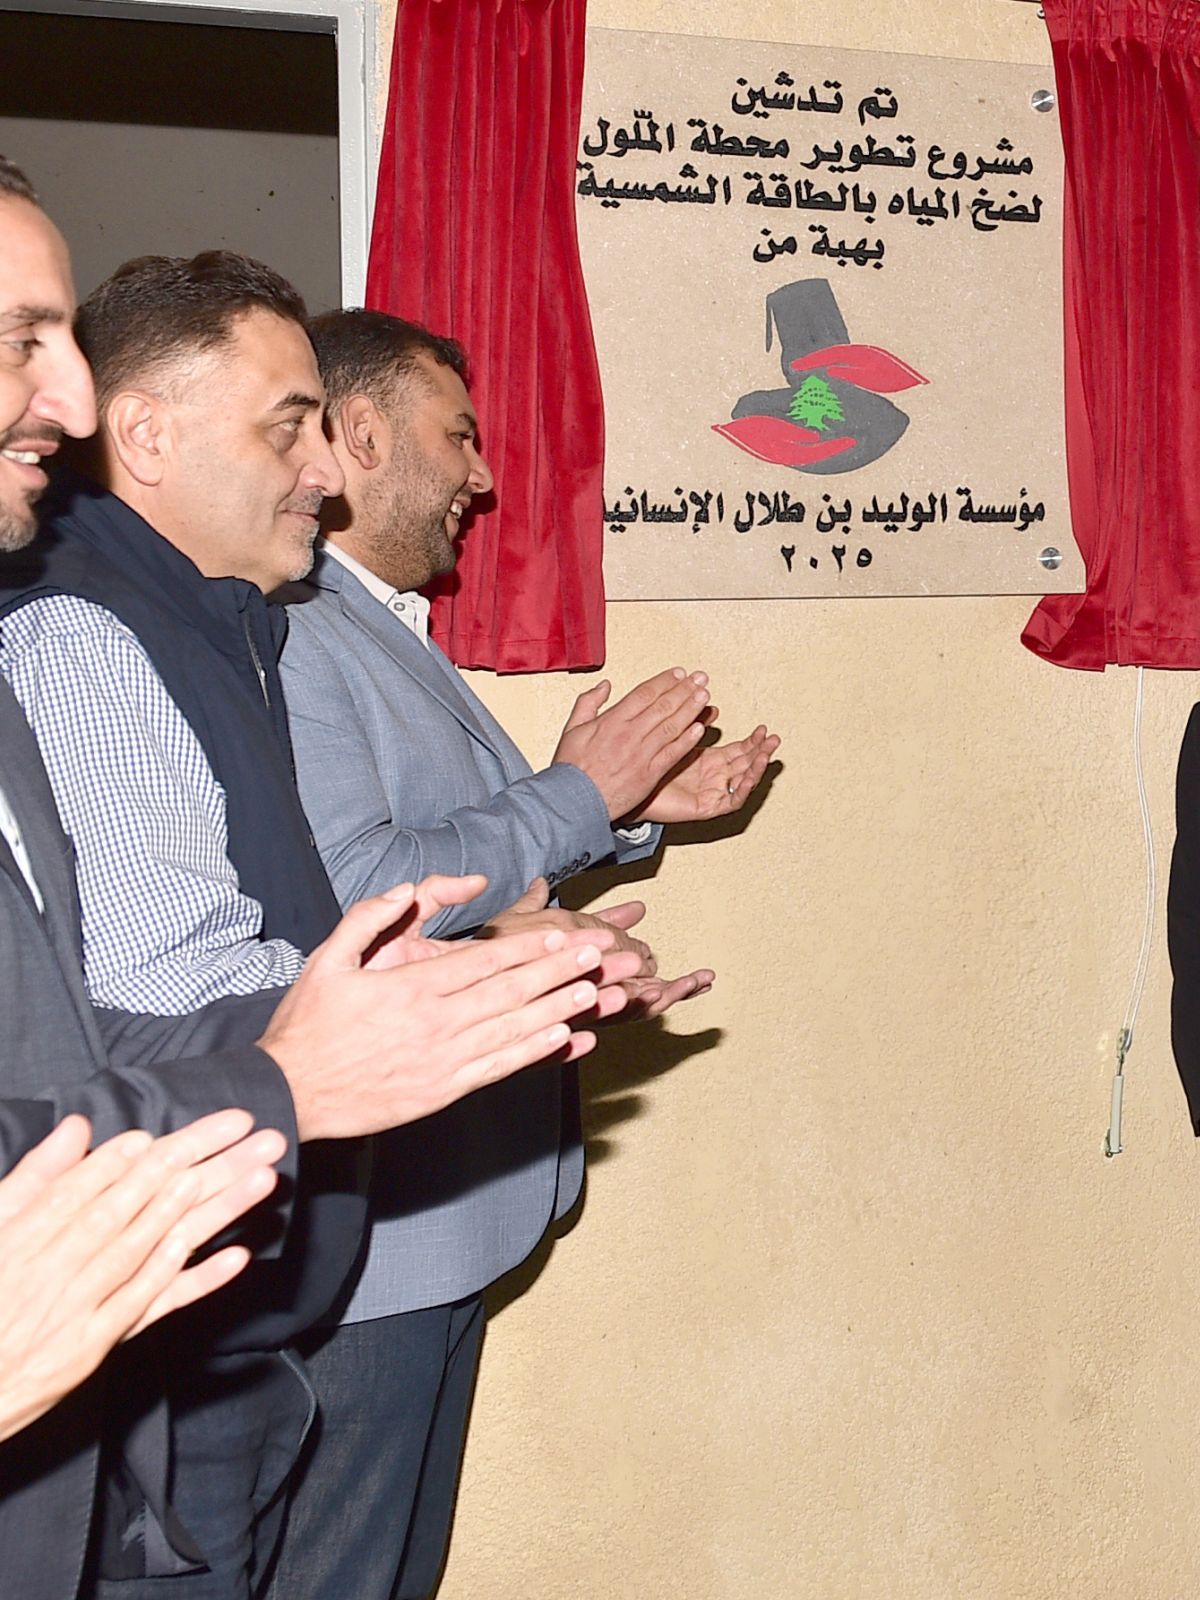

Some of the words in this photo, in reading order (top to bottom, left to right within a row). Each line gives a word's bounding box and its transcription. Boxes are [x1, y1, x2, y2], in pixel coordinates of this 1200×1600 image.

[731, 70, 844, 119] تدشين
[857, 87, 899, 126] تم
[686, 118, 790, 159] محطة
[800, 134, 917, 173] تطوير
[927, 137, 1034, 181] مشروع
[576, 160, 732, 209] الشمسية
[742, 171, 877, 225] بالطاقة
[888, 186, 960, 226] المياه
[970, 187, 1043, 231] لضخ
[752, 229, 798, 263] من
[807, 224, 885, 270] بهبة
[602, 485, 725, 535] الإنساني
[733, 490, 806, 534] طلال
[815, 493, 852, 535] بن
[861, 491, 948, 532] الوليد
[955, 486, 1046, 532] مؤسسة
[780, 544, 873, 574] ٢٠٢٥
